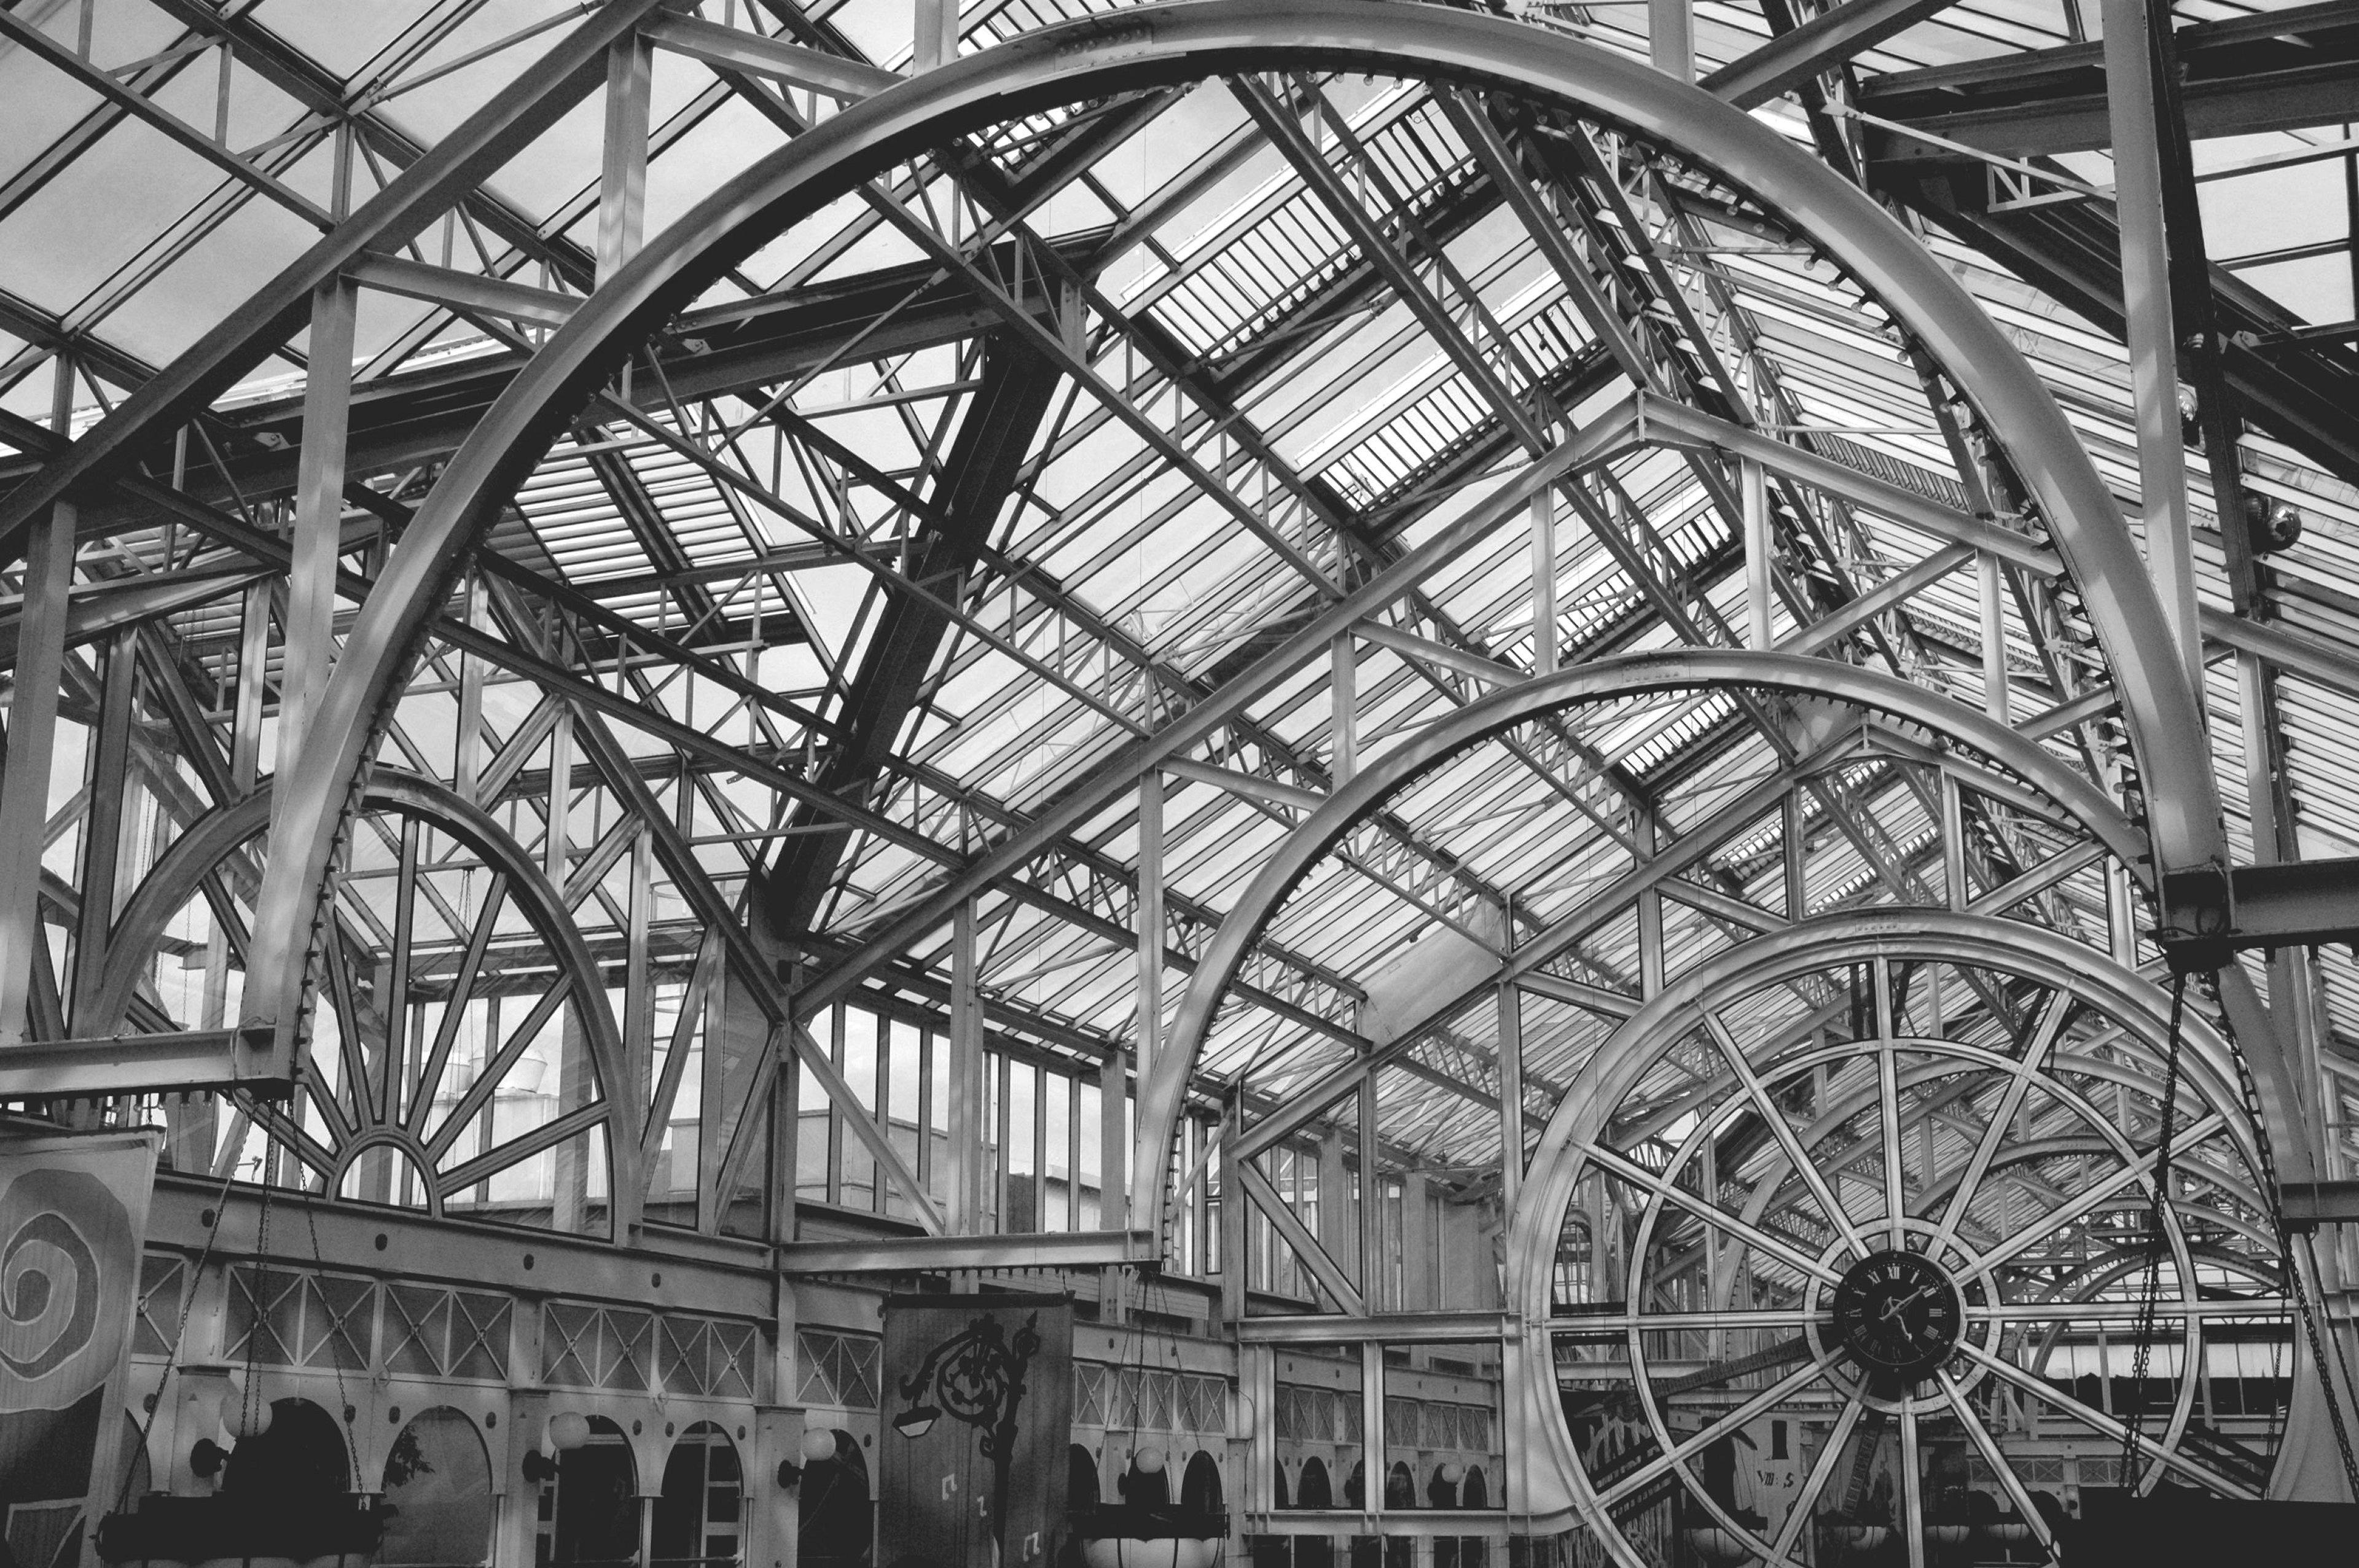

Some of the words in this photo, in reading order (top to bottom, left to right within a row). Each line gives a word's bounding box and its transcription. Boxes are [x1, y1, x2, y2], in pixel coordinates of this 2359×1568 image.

[1867, 1270, 1881, 1285] XI
[1887, 1266, 1900, 1279] XII
[1910, 1271, 1919, 1284] I
[1854, 1288, 1867, 1298] X
[1922, 1287, 1936, 1298] II
[1929, 1308, 1942, 1317] III
